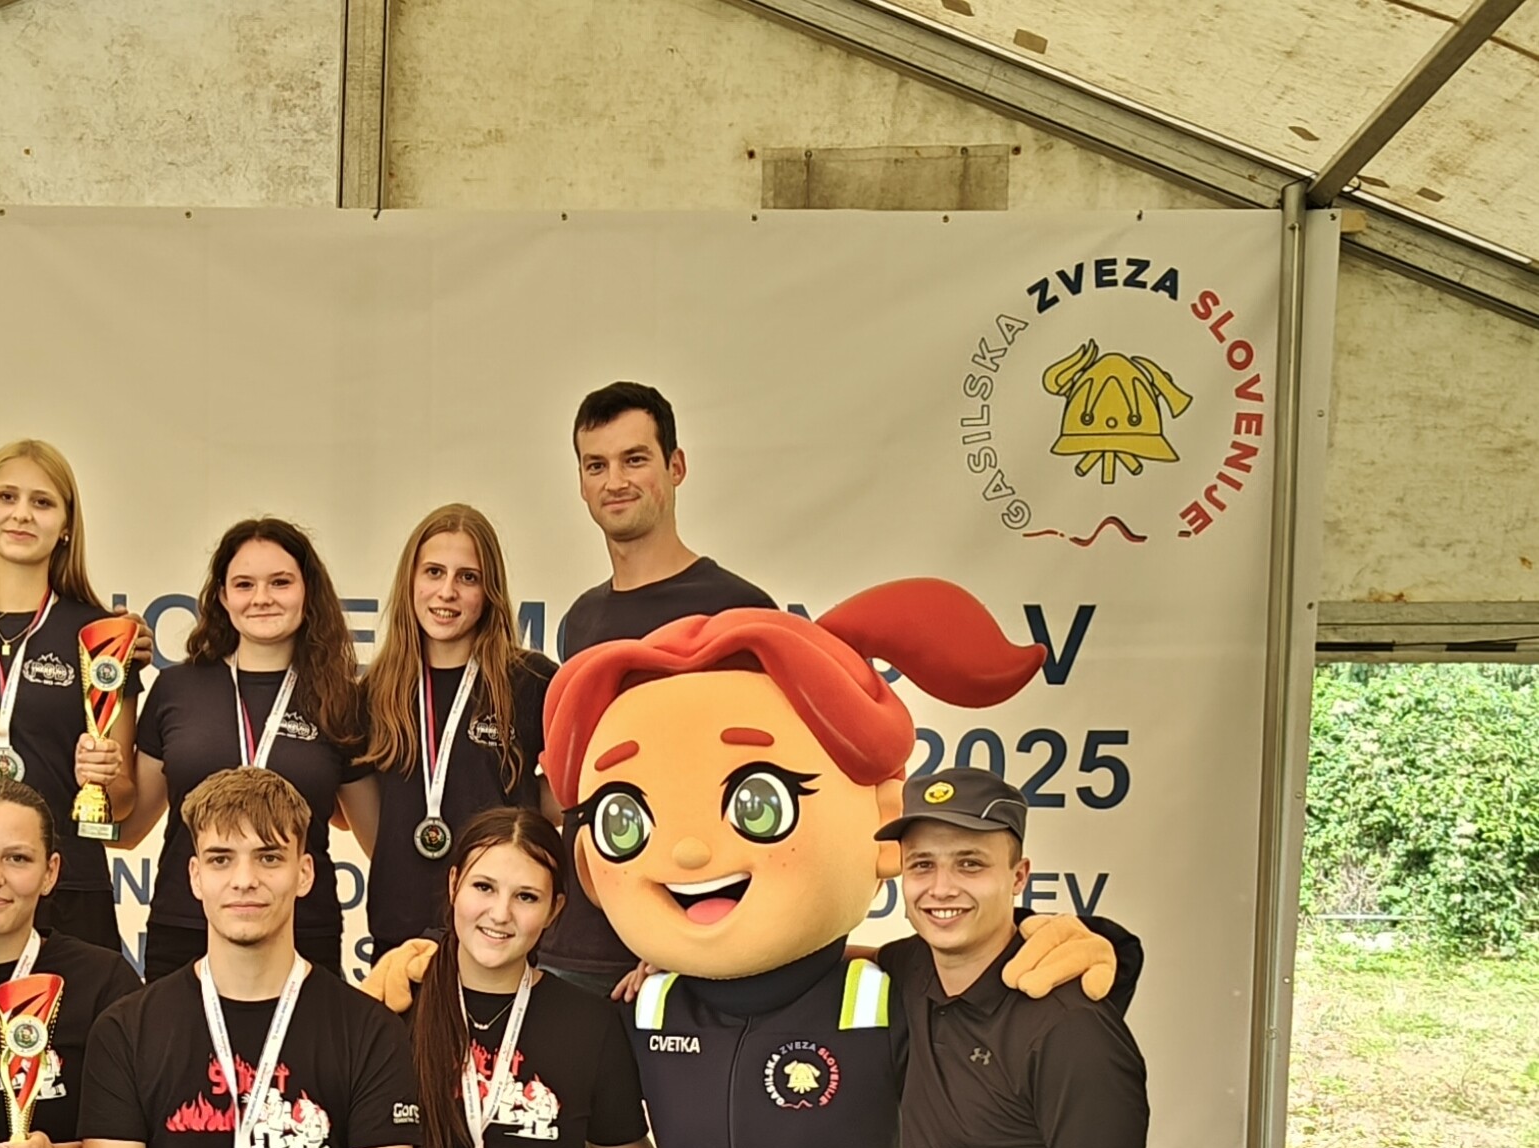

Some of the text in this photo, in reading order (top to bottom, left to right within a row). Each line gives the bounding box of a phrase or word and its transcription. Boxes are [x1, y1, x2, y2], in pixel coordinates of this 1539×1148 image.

[960, 257, 1265, 536] GASILSKA ZVEZA SLOVENIJE
[649, 1035, 701, 1054] CVETKA
[763, 1053, 785, 1106] GASILSKA
[779, 1041, 816, 1055] ZVEZA
